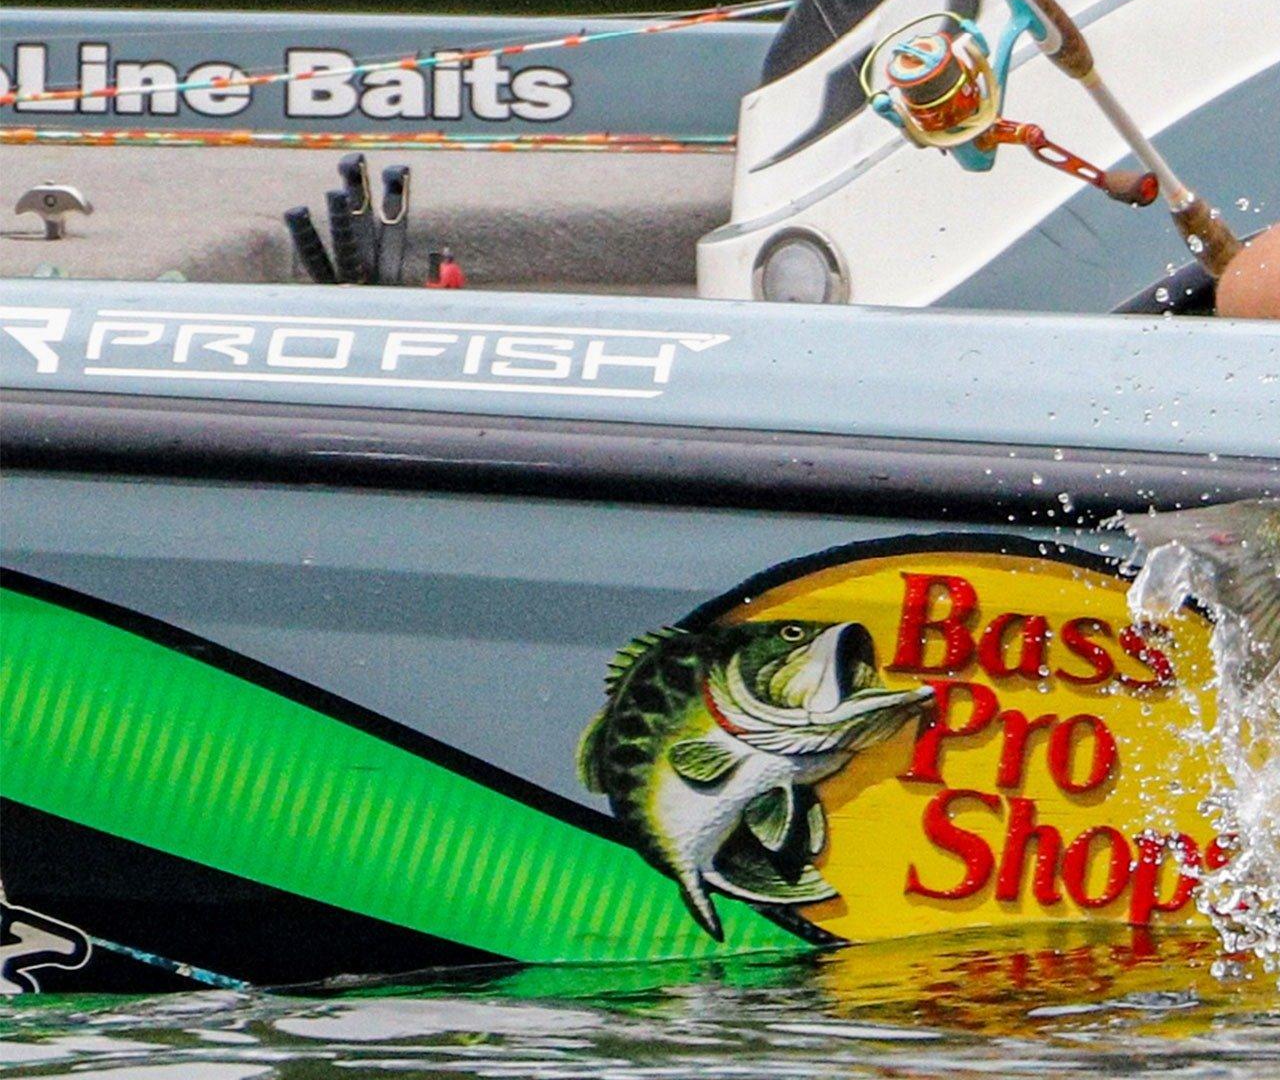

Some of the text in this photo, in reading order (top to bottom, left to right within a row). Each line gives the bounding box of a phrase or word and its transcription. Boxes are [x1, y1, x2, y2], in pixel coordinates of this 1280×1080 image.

[0, 42, 573, 121] Line Baits
[86, 320, 679, 385] PRO FISH
[884, 570, 1176, 690] Bass
[896, 679, 1119, 795] Pro
